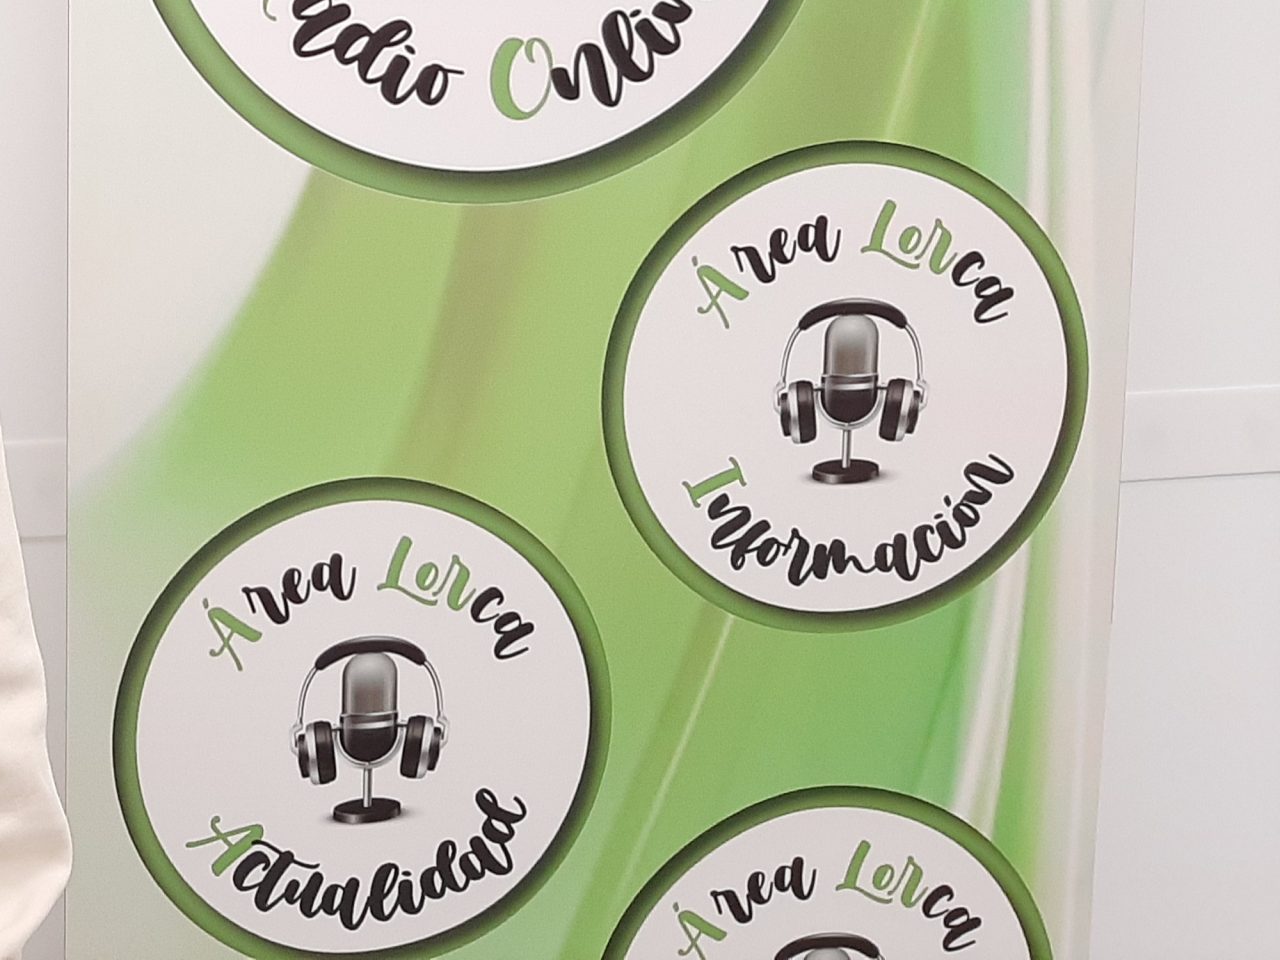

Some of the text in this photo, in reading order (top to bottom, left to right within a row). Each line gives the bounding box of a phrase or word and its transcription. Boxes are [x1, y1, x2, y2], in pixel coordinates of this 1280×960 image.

[692, 199, 1014, 329] Área Lorca
[682, 453, 1015, 586] Información
[202, 535, 535, 672] Área Lorca
[185, 788, 527, 931] Actualidad
[672, 839, 982, 960] Área Lorca
